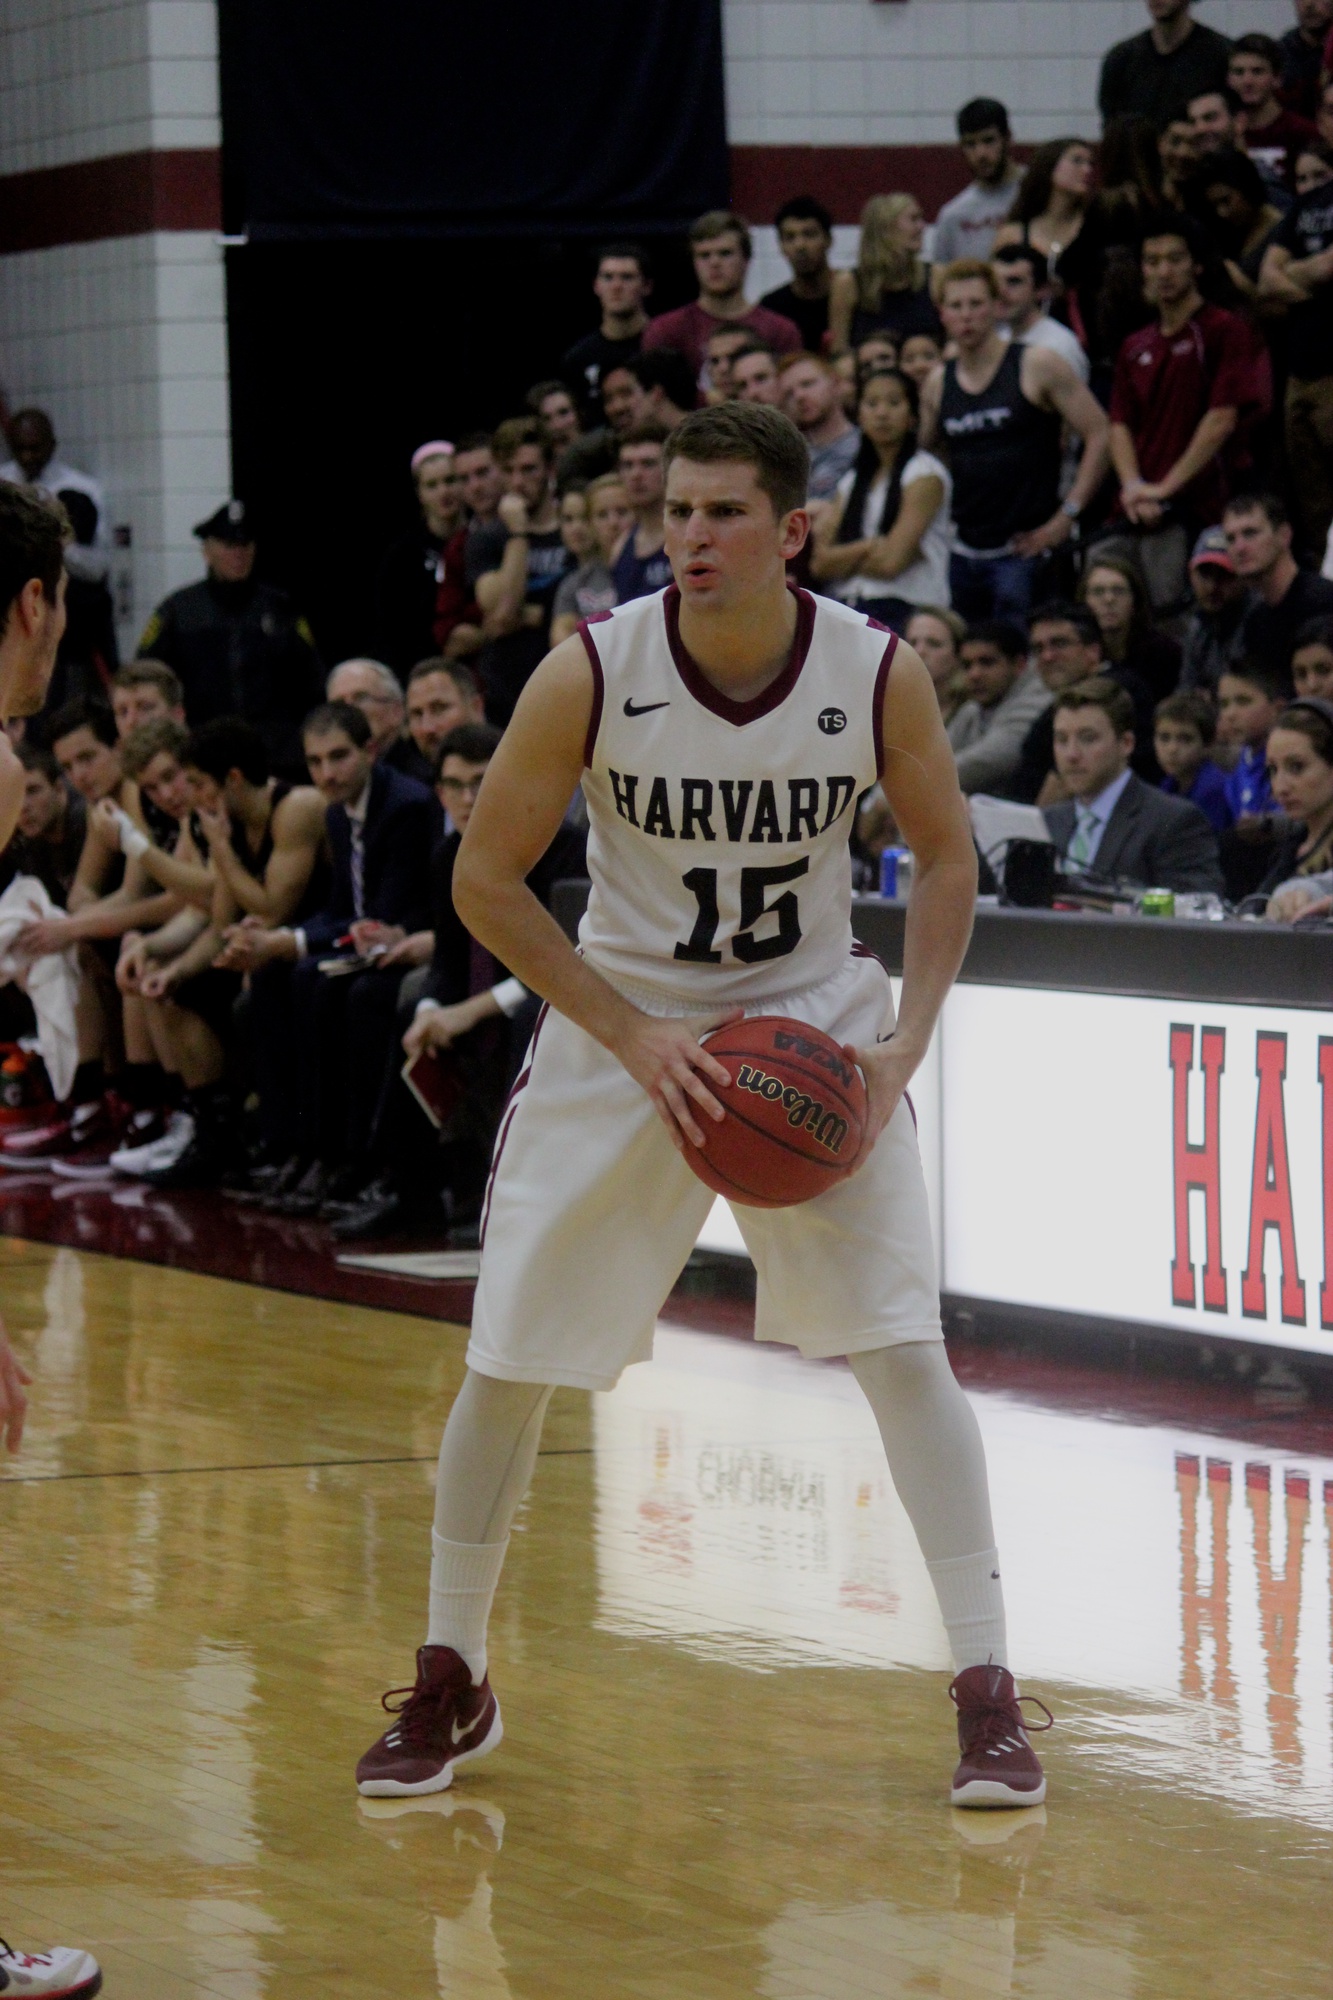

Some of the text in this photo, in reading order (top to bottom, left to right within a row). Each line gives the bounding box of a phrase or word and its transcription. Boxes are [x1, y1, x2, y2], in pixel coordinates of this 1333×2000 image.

[820, 713, 846, 730] TS
[608, 767, 857, 844] HARVARD
[673, 855, 810, 964] 15
[736, 1064, 849, 1155] Wilson
